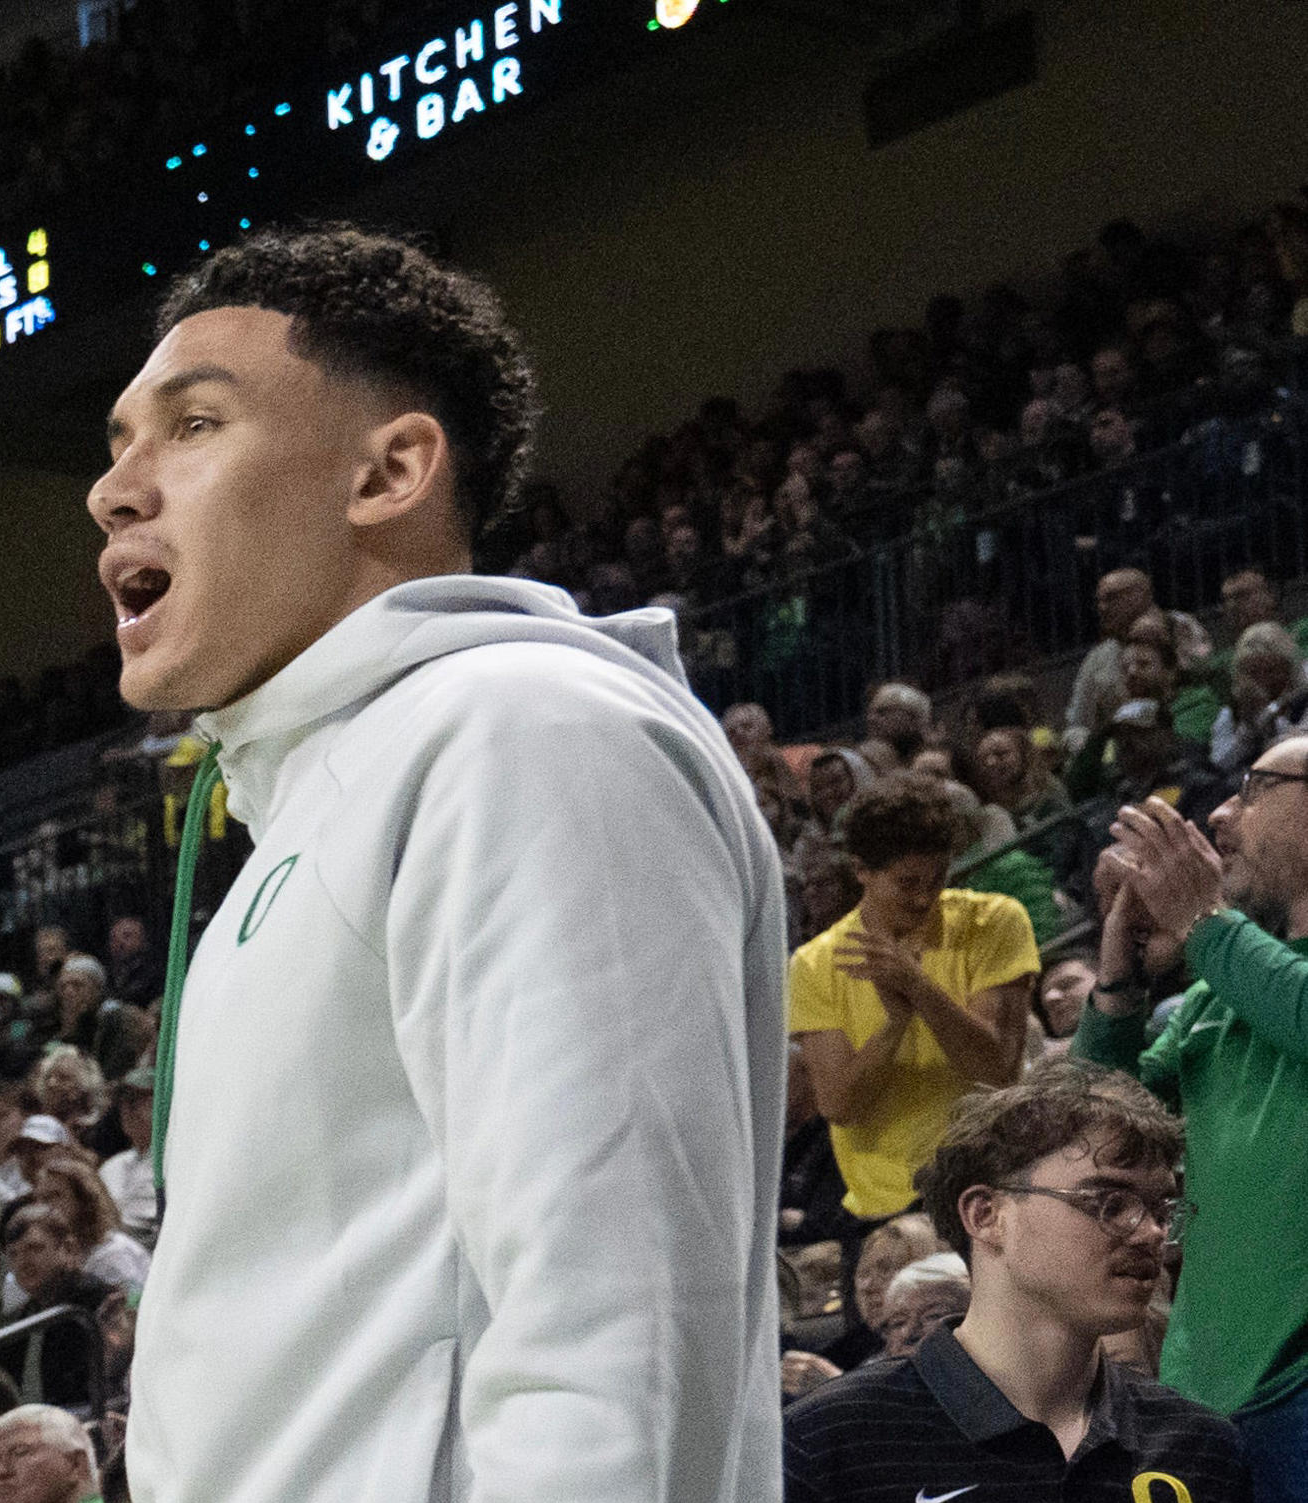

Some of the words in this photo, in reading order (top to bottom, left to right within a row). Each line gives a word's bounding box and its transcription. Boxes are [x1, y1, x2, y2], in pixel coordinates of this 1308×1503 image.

[327, 0, 562, 130] KITCHEN
[366, 116, 400, 160] &
[416, 57, 523, 139] BAR
